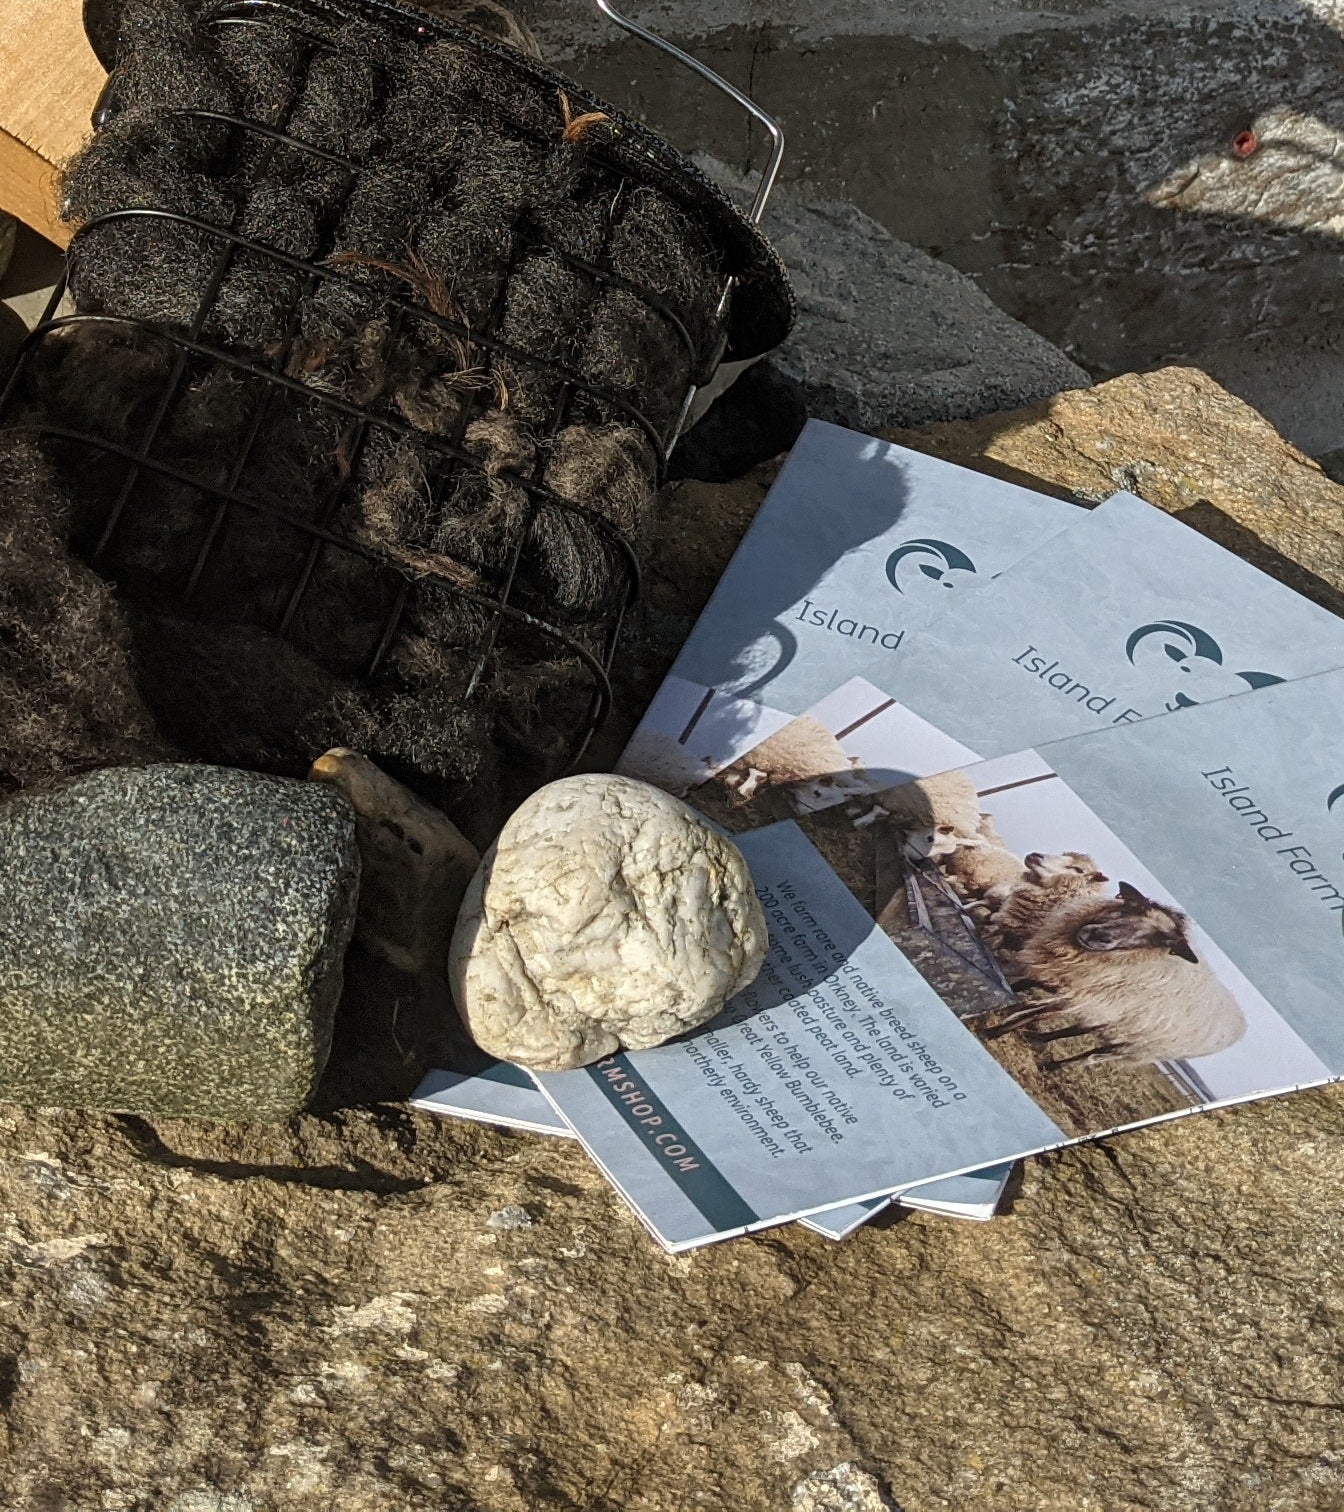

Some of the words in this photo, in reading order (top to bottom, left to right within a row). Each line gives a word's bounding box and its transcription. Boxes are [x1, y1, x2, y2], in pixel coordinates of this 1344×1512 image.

[795, 599, 905, 651] Island
[1011, 645, 1117, 715] Island
[1201, 765, 1293, 842] Island
[1275, 845, 1344, 911] Farm
[755, 886, 779, 908] 200
[771, 909, 796, 934] acre
[791, 933, 818, 962] farm
[812, 959, 828, 974] in
[858, 1014, 881, 1037] The
[876, 1035, 908, 1063] land
[897, 1060, 914, 1073] is
[908, 1072, 951, 1110] varied
[776, 879, 796, 901] We
[791, 900, 817, 928] farm
[812, 928, 837, 952] rare
[831, 952, 860, 975] and
[849, 974, 884, 1009] native
[878, 1007, 918, 1041] breed
[907, 1040, 943, 1075] sheep
[938, 1075, 958, 1091] on
[953, 1092, 967, 1101] a
[787, 962, 814, 989] lush
[806, 988, 848, 1031] pasture
[731, 1014, 764, 1045] Great
[756, 1043, 792, 1080] Yellow
[784, 1079, 844, 1145] Bumblebee.
[772, 1031, 789, 1045] to
[783, 1044, 811, 1070] help
[805, 1070, 829, 1090] our
[821, 1090, 859, 1125] native
[778, 987, 819, 1026] coated
[804, 1025, 840, 1052] peat
[831, 1049, 863, 1080] land.
[842, 1030, 872, 1053] and
[856, 1052, 898, 1087] plenty
[679, 1038, 727, 1088] northerly
[719, 1087, 786, 1159] environment.
[728, 1062, 763, 1096] hardy
[754, 1095, 790, 1130] sheep
[783, 1128, 814, 1155] that
[892, 1088, 916, 1100] of
